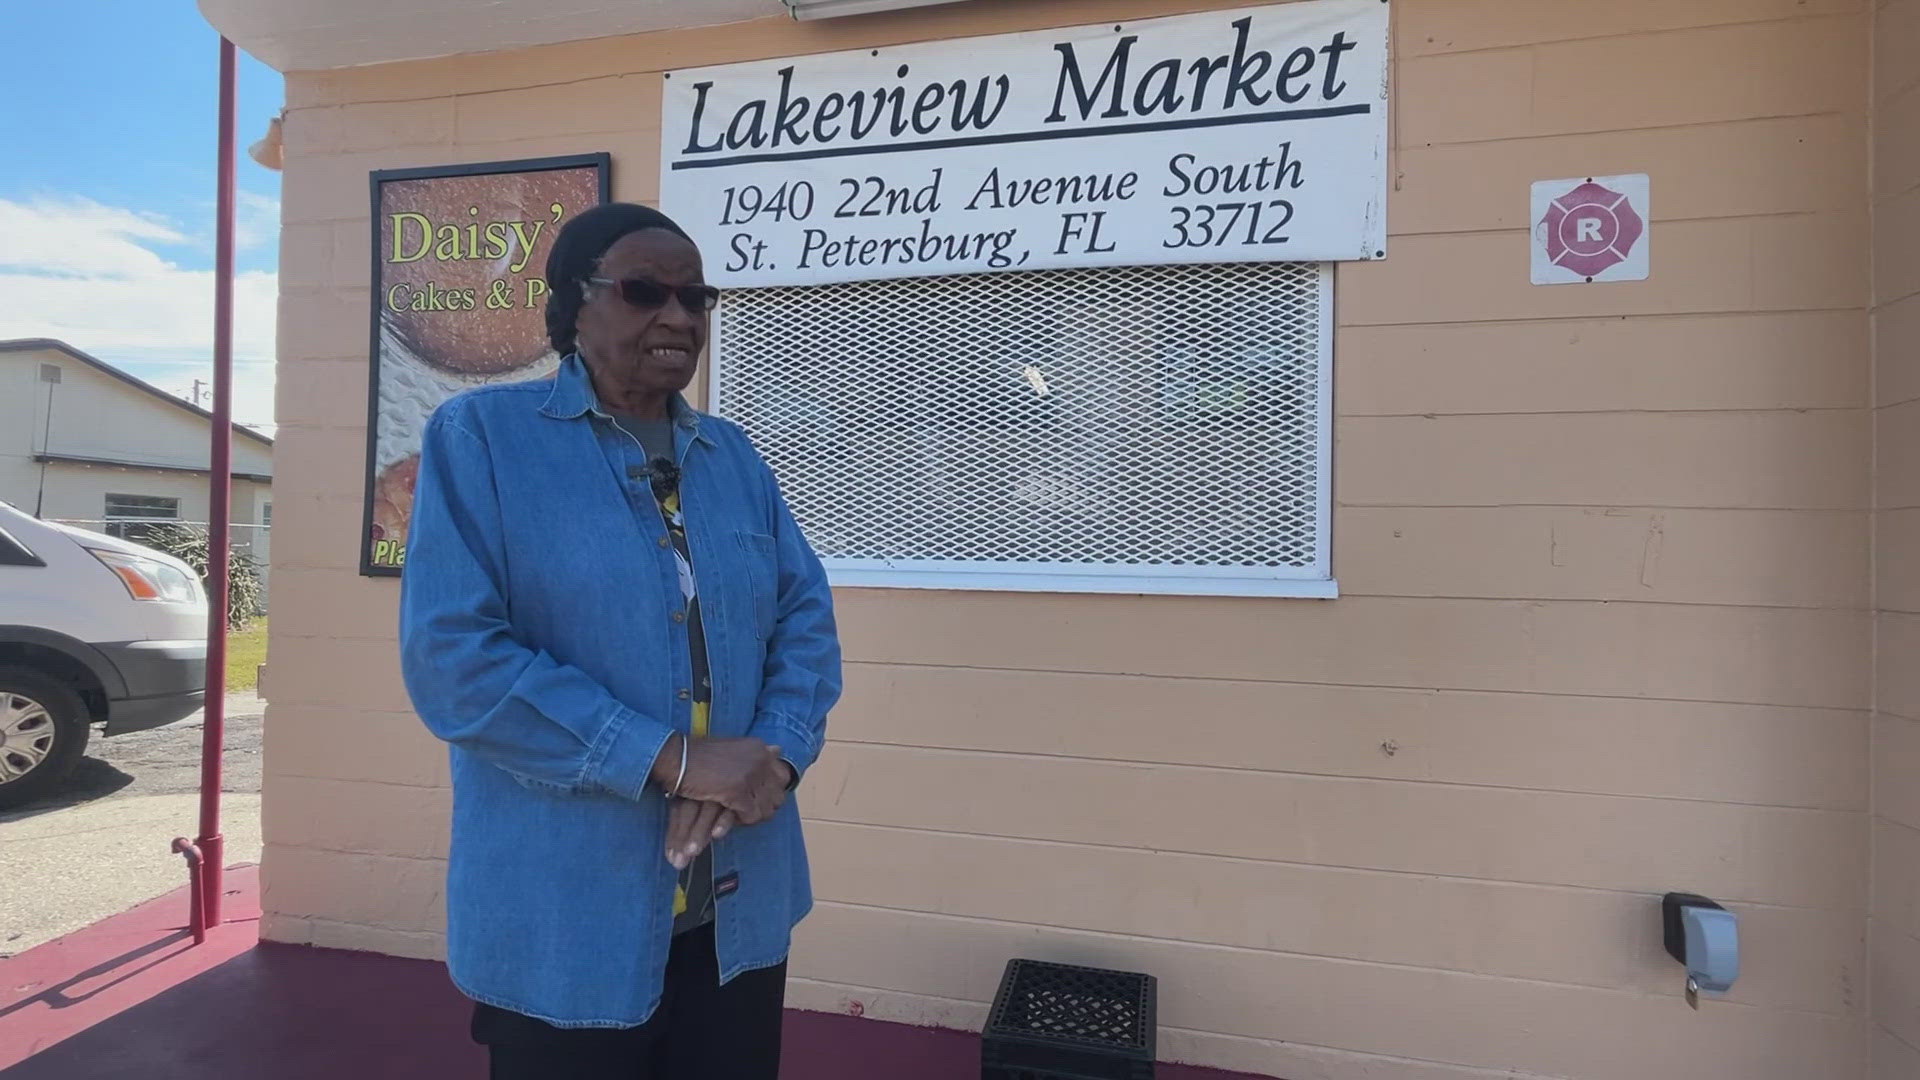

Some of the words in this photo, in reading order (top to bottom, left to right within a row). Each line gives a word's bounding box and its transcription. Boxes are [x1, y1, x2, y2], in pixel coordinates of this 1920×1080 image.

[682, 64, 1009, 155] Lakeview
[1044, 15, 1358, 124] Market
[718, 181, 814, 226] 1940
[833, 167, 943, 218] 22nd
[963, 167, 1138, 210] Avenue
[1163, 141, 1305, 197] South
[387, 202, 564, 274] Daisy'
[725, 233, 776, 272] St.
[797, 218, 1030, 269] Petersburg,
[1053, 211, 1117, 255] FL
[1162, 199, 1294, 249] 33712
[1577, 217, 1603, 242] R
[387, 282, 476, 313] Cakes
[484, 278, 515, 310] &
[524, 277, 552, 309] P
[373, 539, 407, 566] Pla
